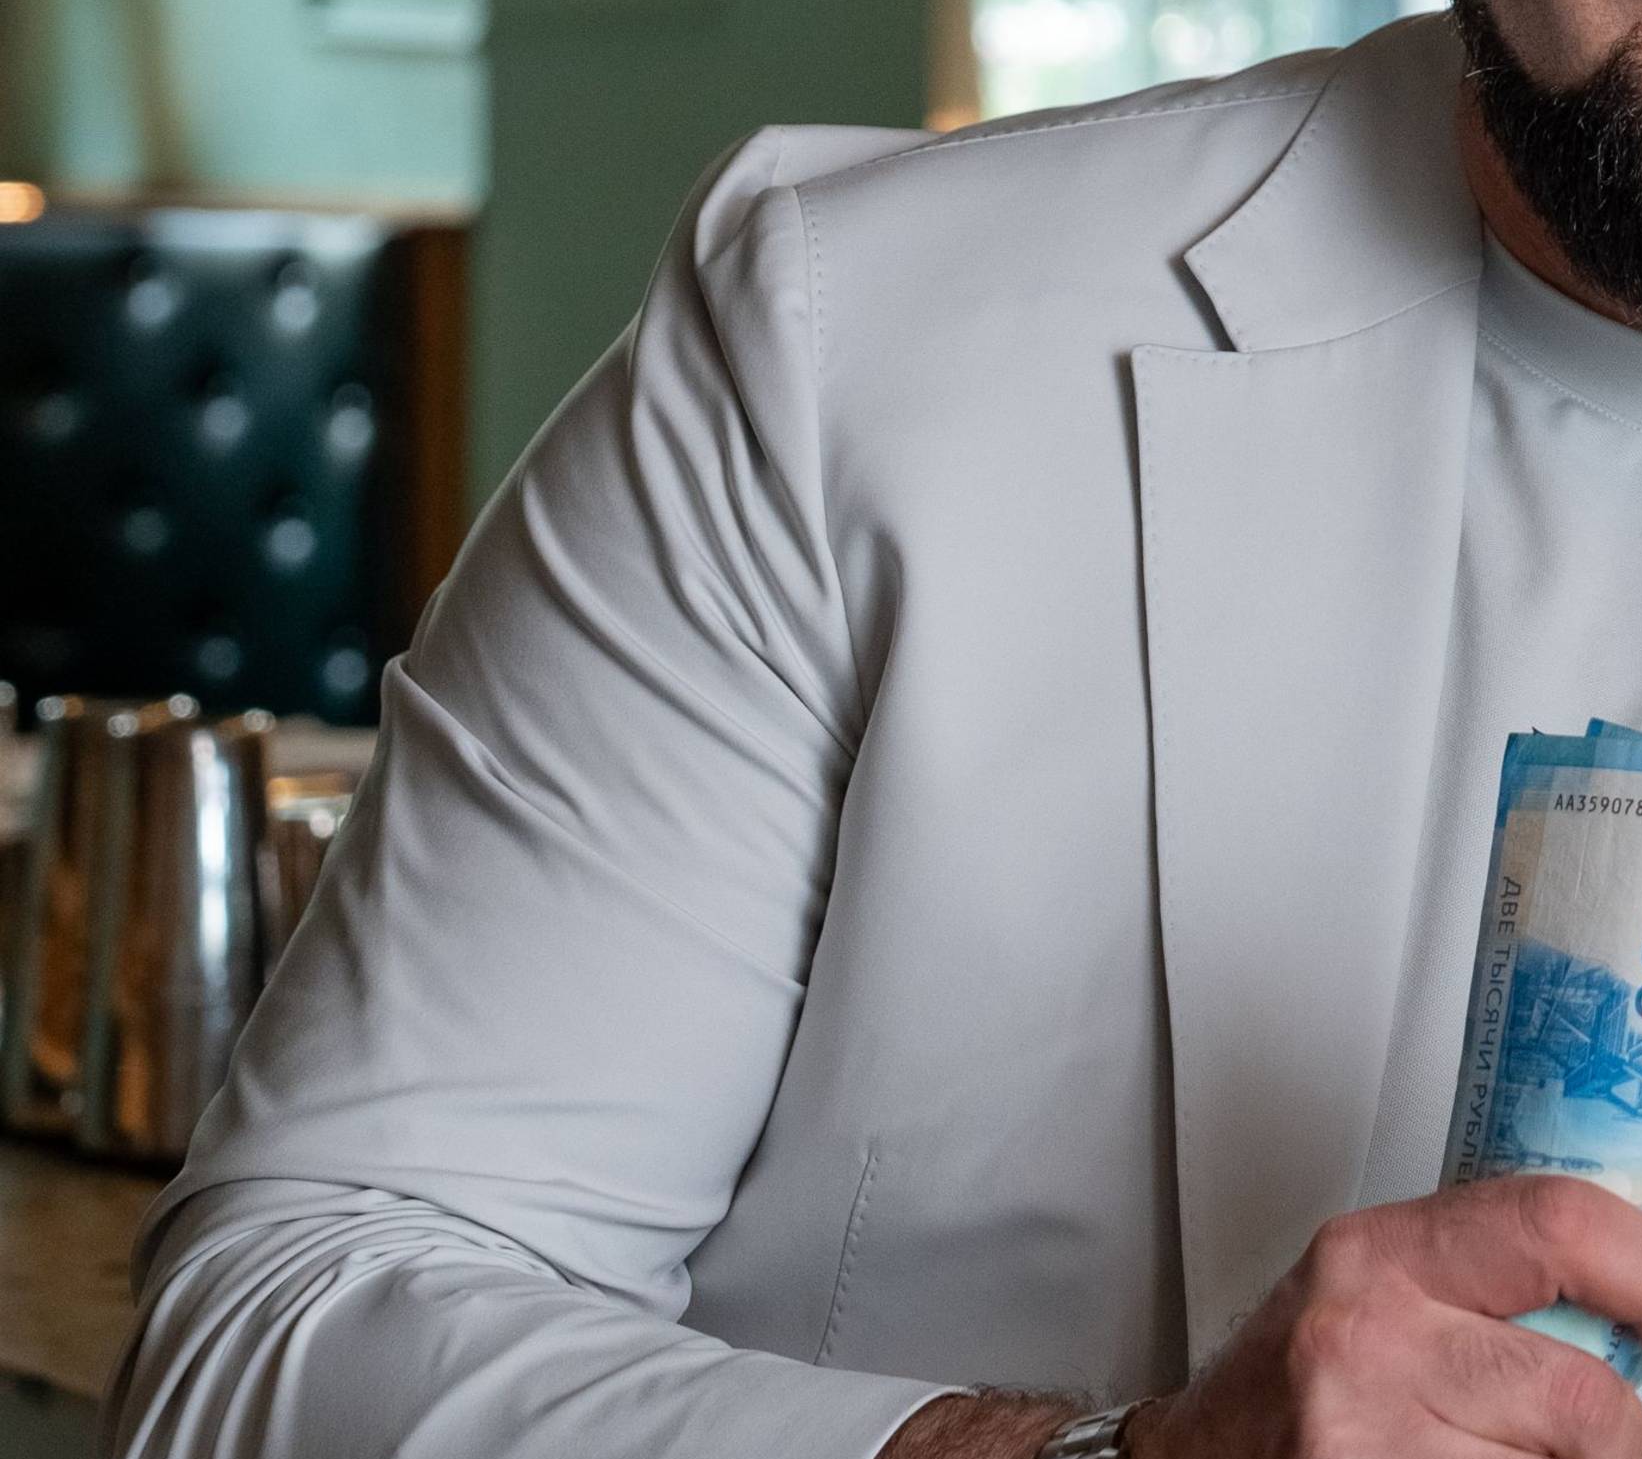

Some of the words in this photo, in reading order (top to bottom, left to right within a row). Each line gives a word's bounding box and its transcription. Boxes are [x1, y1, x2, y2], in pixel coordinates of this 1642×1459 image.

[1498, 875, 1522, 934] ДВЕ
[1474, 944, 1511, 1072] ТЫСЯЧИ
[1456, 1083, 1488, 1185] РУБЛЕ
